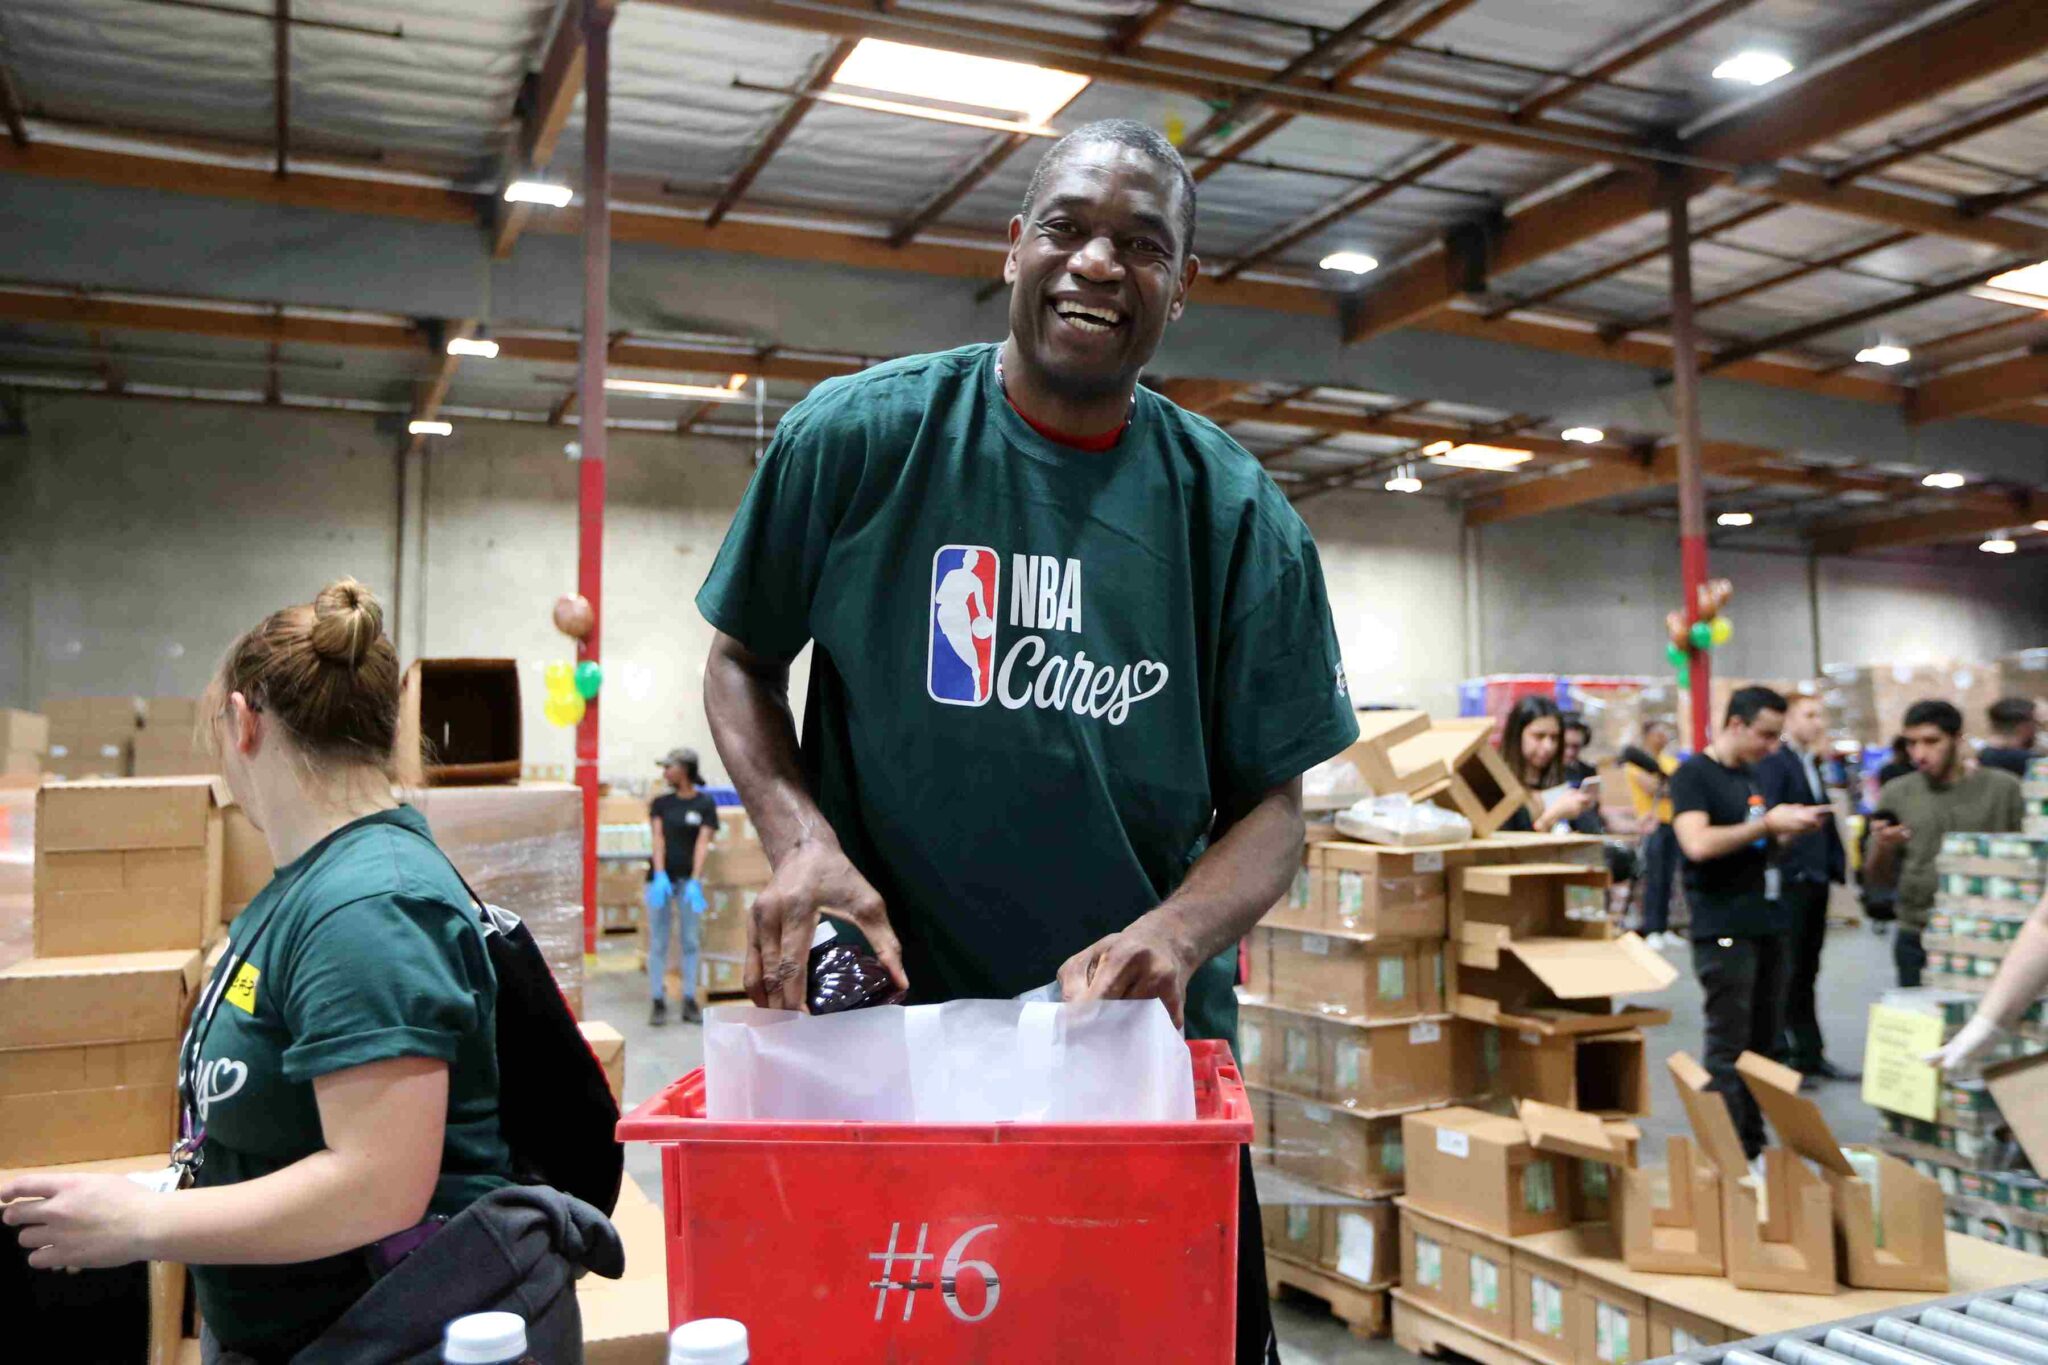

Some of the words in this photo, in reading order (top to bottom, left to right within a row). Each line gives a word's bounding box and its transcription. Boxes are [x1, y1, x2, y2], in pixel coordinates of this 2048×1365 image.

[1010, 553, 1082, 634] NBA
[996, 635, 1140, 726] Cares
[868, 1222, 1000, 1322] #6
